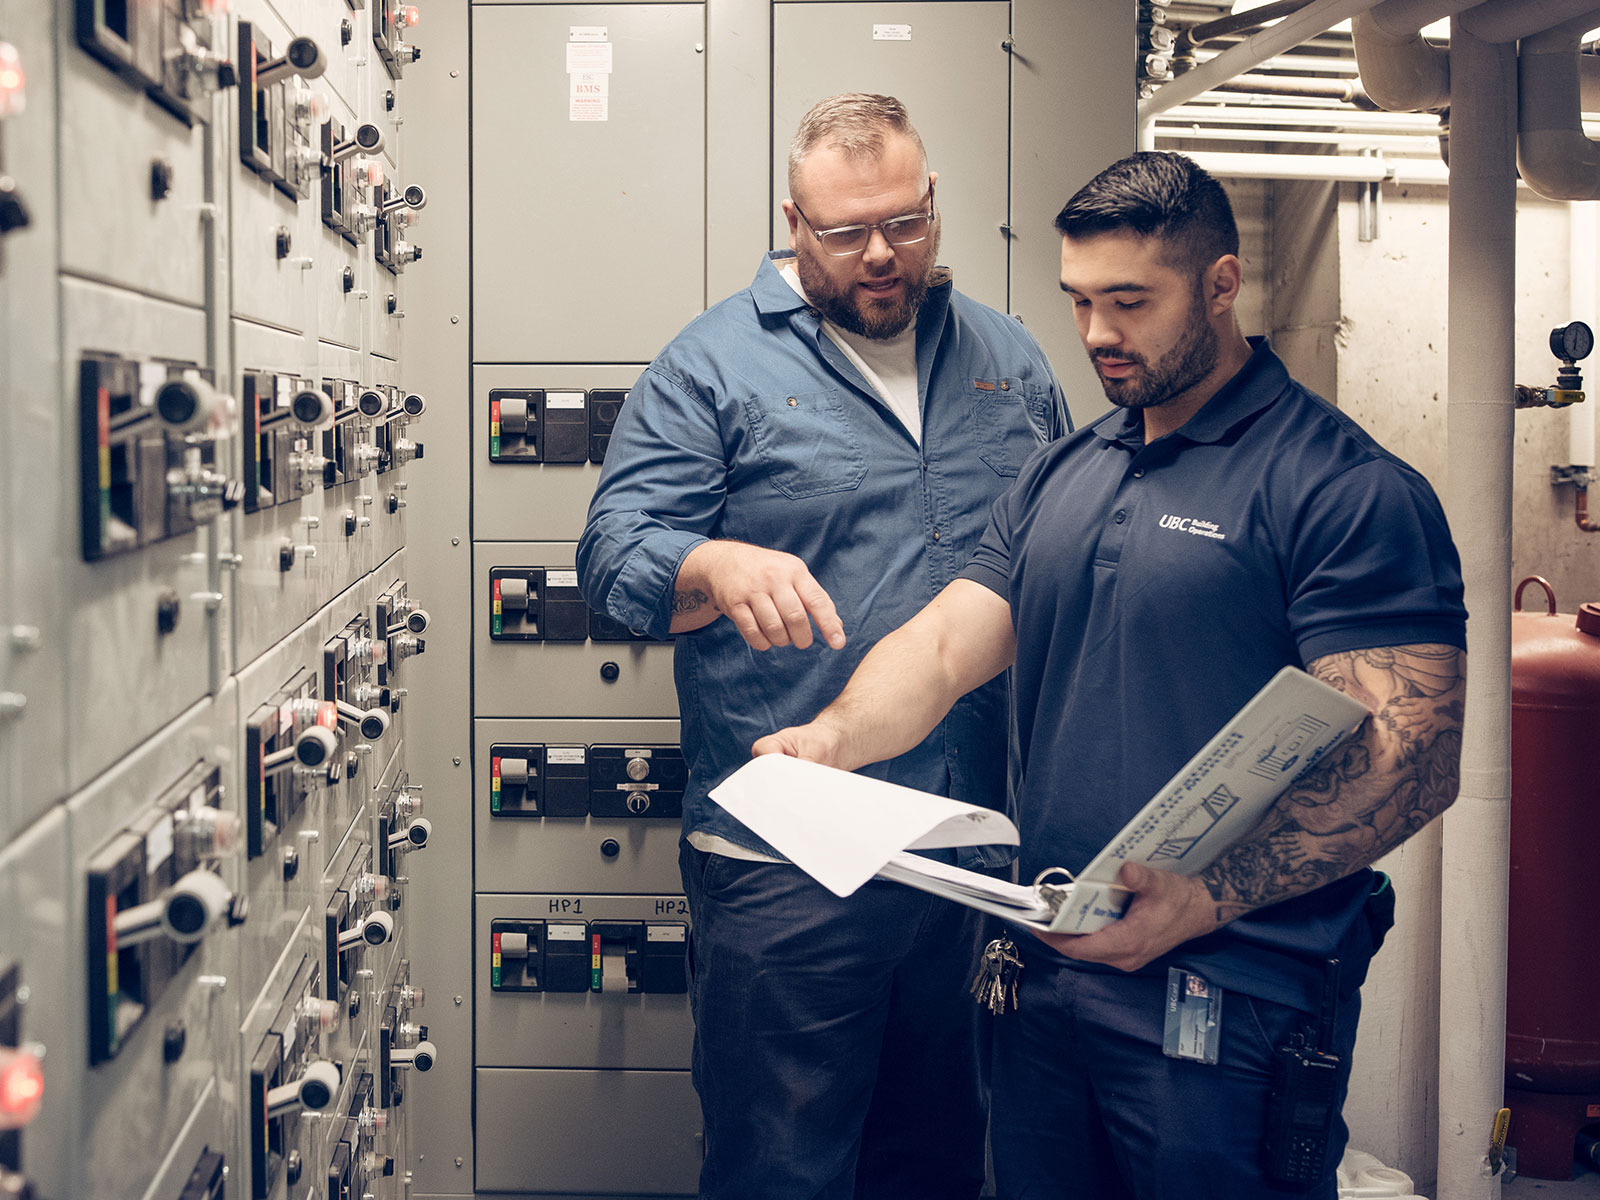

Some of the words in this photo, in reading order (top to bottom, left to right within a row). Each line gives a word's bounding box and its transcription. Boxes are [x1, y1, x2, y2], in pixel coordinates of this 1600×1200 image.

[576, 84, 601, 93] BMS
[1158, 514, 1192, 532] UBC
[1191, 519, 1220, 533] Building
[1187, 526, 1226, 540] Operations
[549, 899, 583, 914] HP1
[655, 900, 690, 915] HP2
